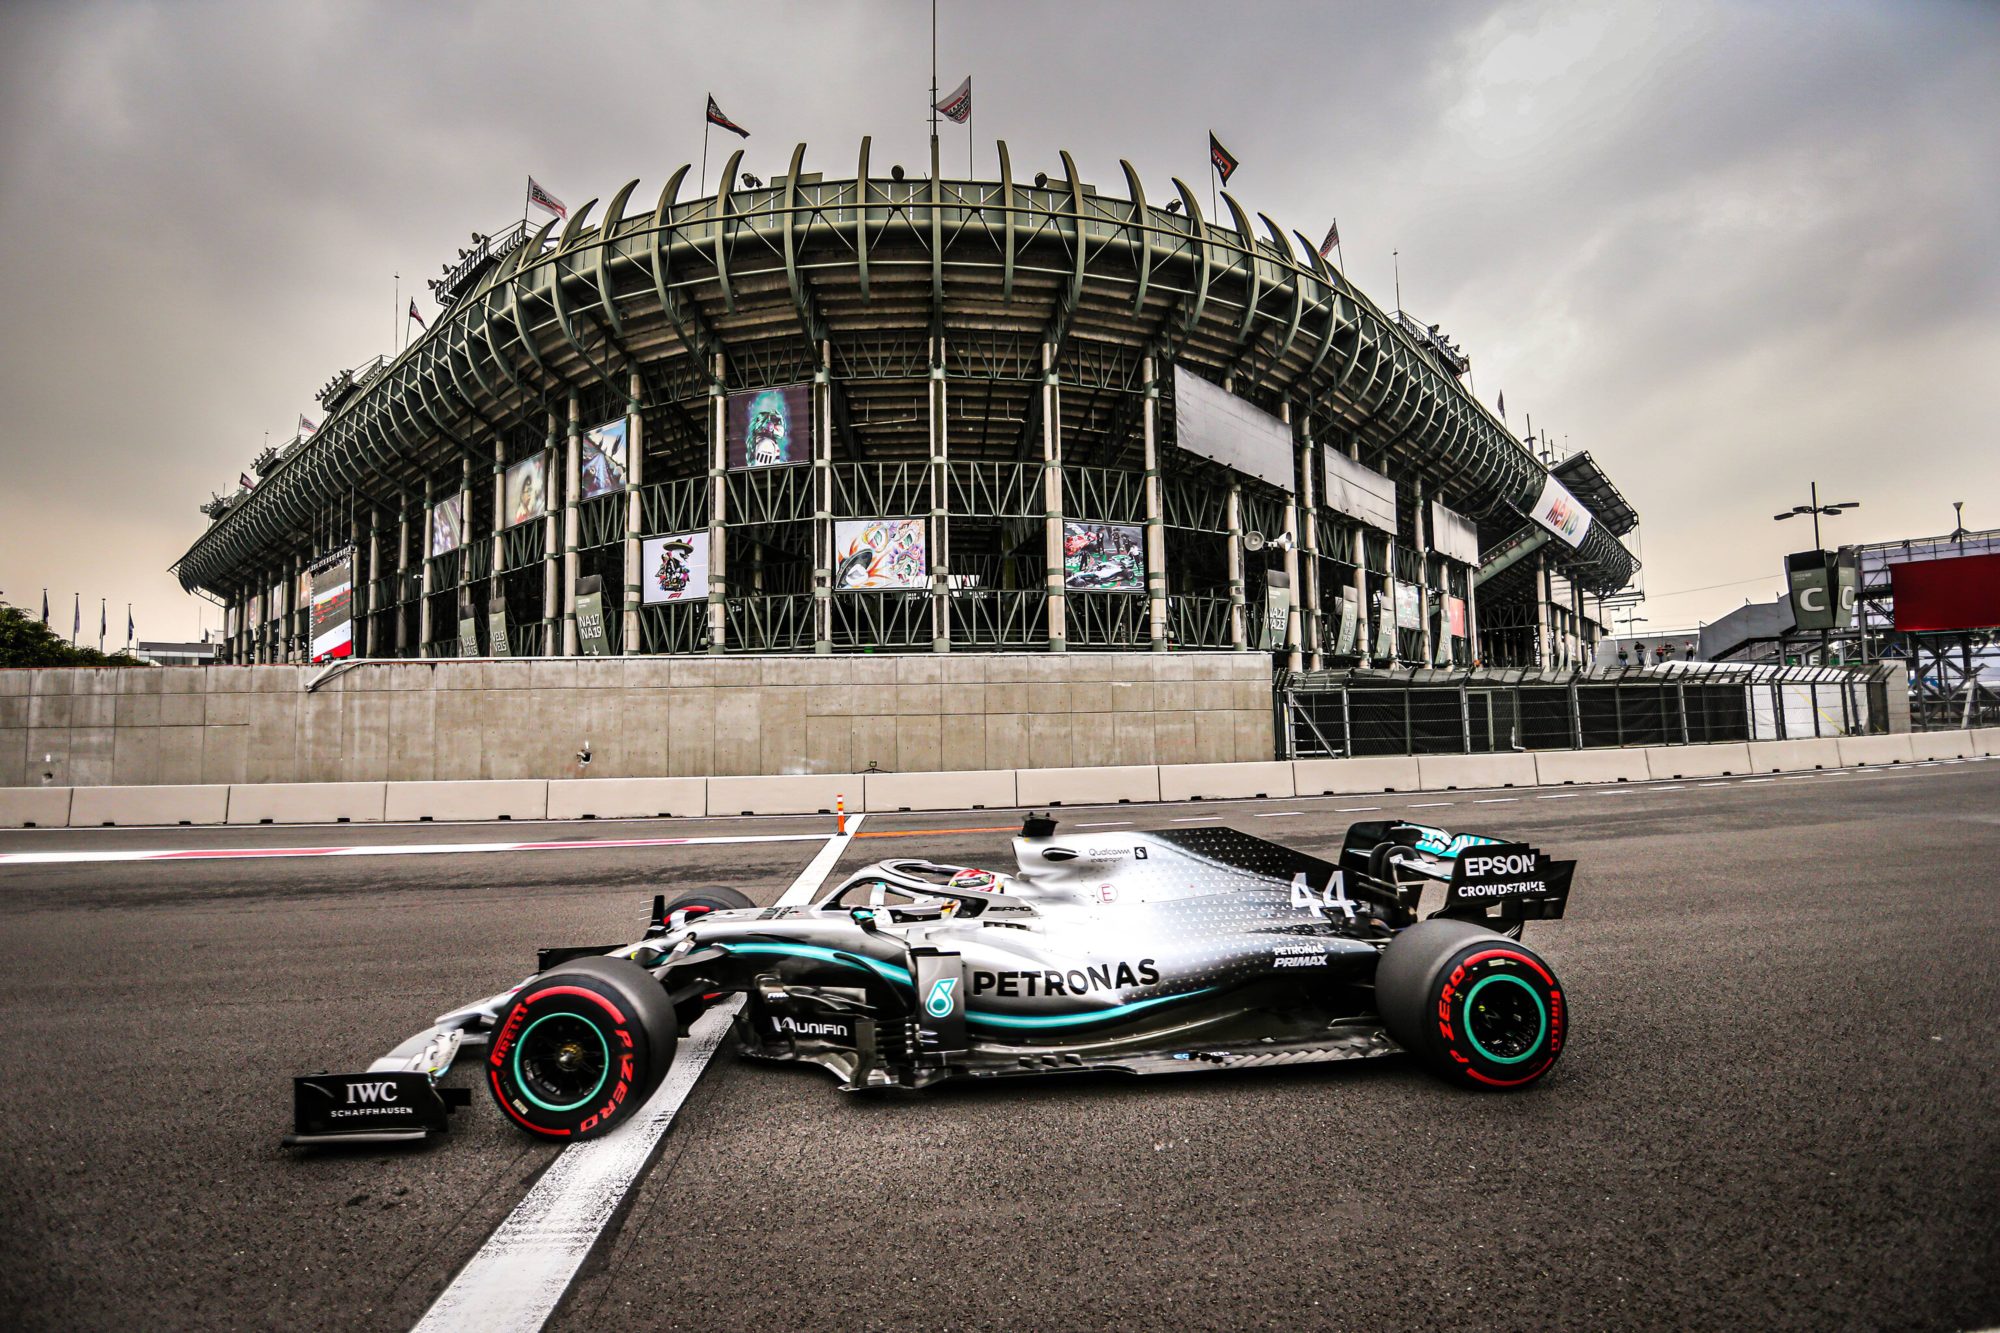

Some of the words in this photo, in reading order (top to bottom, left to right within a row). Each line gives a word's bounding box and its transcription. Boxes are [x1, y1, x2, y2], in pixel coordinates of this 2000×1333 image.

[1800, 587, 1824, 612] C
[579, 614, 600, 628] NA17
[581, 626, 602, 640] NA19
[1464, 853, 1536, 877] EPSON
[1291, 870, 1358, 918] 44
[1457, 881, 1547, 898] CROWDSTRIKE
[1272, 943, 1326, 956] PETRONAS
[1273, 954, 1329, 968] PRIMAX
[972, 958, 1160, 998] PETRONAS
[1438, 965, 1466, 1041] ZERO
[346, 1081, 398, 1104] IWC
[580, 1052, 634, 1133] ZERO
[330, 1107, 414, 1118] SCHAFFHAUSEN
